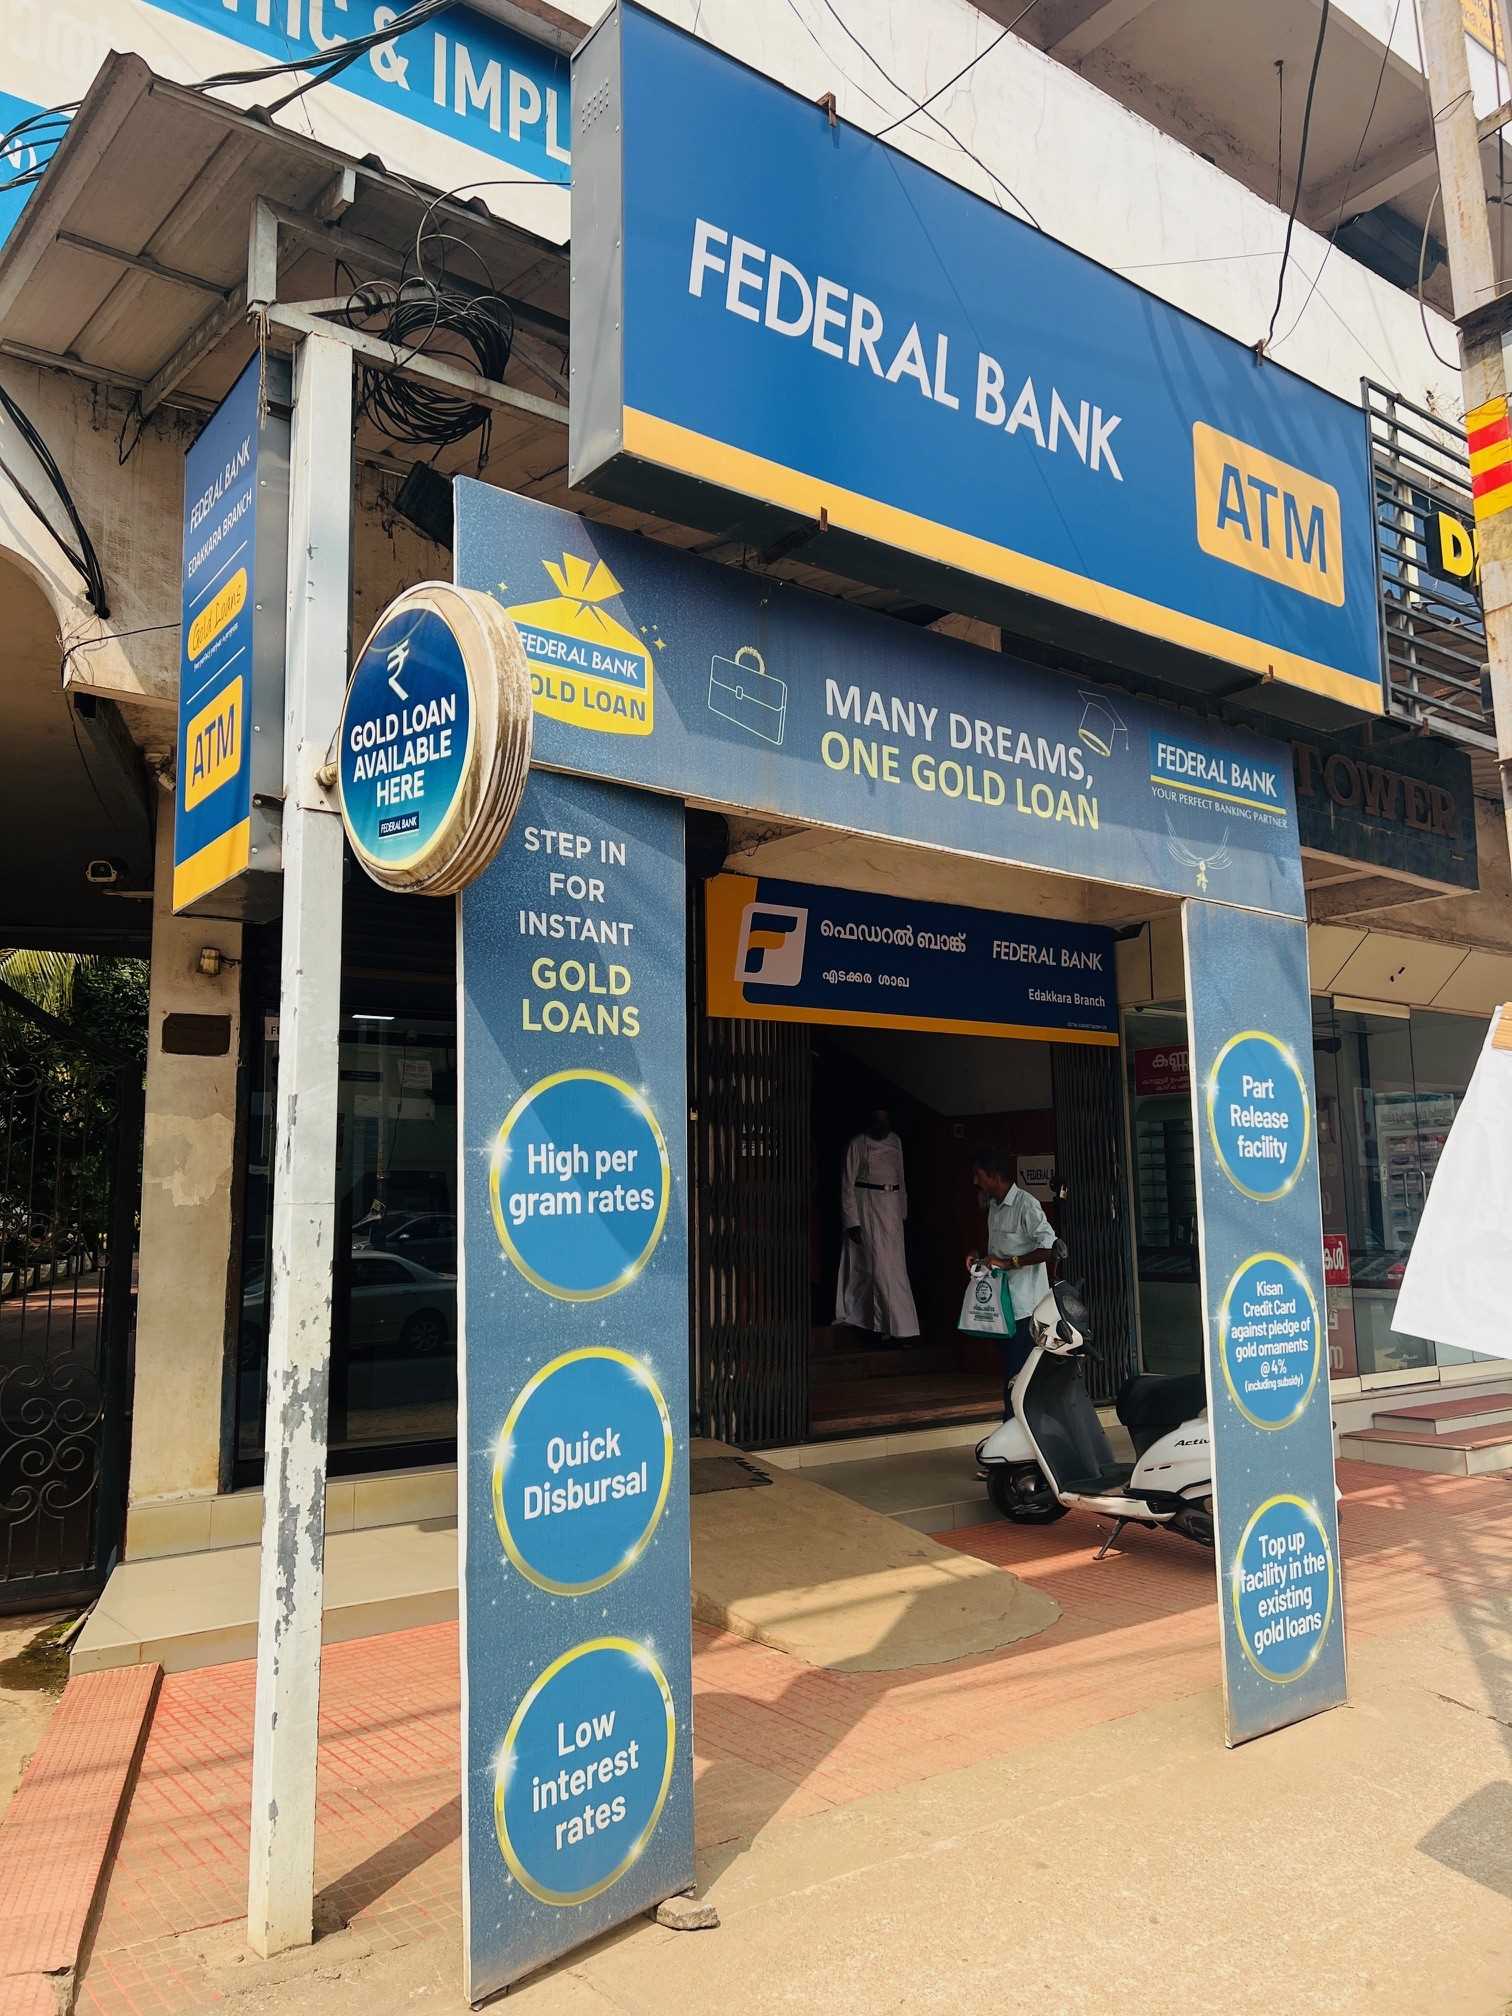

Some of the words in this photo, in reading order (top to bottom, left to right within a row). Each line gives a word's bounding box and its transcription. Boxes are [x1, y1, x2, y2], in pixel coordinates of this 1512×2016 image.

[688, 217, 960, 411] FEDERAL
[975, 351, 1124, 483] BANK
[189, 472, 224, 534] FEDERAL
[224, 434, 252, 488] BANK
[188, 526, 222, 579] EDAKKARA
[222, 488, 253, 536] BRANCH
[1216, 463, 1328, 575] ATM
[591, 651, 639, 680] BANK
[530, 672, 577, 704] OLD
[583, 686, 646, 722] LOAN
[350, 714, 399, 752] GOLD
[402, 693, 456, 736] LOAN
[825, 678, 939, 742] MANY
[949, 712, 1094, 790] DREAMS,
[191, 703, 235, 788] ATM
[353, 728, 452, 783] AVAILABLE
[376, 770, 425, 807] HERE
[820, 730, 901, 784] ONE
[911, 753, 1006, 807] GOLD
[1015, 777, 1099, 830] LOAN
[1157, 742, 1228, 785] FEDERAL
[1231, 763, 1278, 798] BANK
[380, 819, 402, 835] FEDERAL
[401, 815, 419, 830] BANK
[1151, 785, 1177, 801] YOUR
[1179, 793, 1213, 811] PERFECT
[1214, 801, 1252, 821] BANKING
[1253, 813, 1288, 829] PARTNER
[523, 826, 592, 859] STEP
[600, 839, 627, 866] IN
[549, 872, 605, 903] FOR
[519, 910, 634, 946] INSTANT
[531, 957, 632, 995] GOLD
[992, 940, 1057, 966] FEDERAL
[1060, 949, 1103, 972] BANK
[522, 998, 641, 1037] LOANS
[1028, 988, 1072, 1004] Edakkara
[1074, 993, 1106, 1007] Branch
[1242, 1074, 1275, 1099] Part
[1230, 1103, 1289, 1129] Release
[527, 1142, 589, 1182] High
[595, 1149, 638, 1180] per
[1237, 1134, 1288, 1164] facility
[509, 1191, 582, 1225] gram
[588, 1184, 655, 1214] rates
[1243, 1301, 1274, 1318] Credit
[1273, 1298, 1297, 1316] Card
[1256, 1280, 1284, 1297] Kisan
[1231, 1321, 1267, 1342] against
[1268, 1318, 1300, 1339] pledge
[1300, 1316, 1311, 1332] of
[1235, 1341, 1258, 1363] gold
[1257, 1337, 1309, 1356] ornaments
[1244, 1378, 1277, 1394] (including
[1276, 1373, 1304, 1388] subsidy)
[546, 1427, 621, 1474] Quick
[524, 1461, 647, 1520] Disbursal
[1258, 1534, 1286, 1560] Top
[1287, 1531, 1306, 1556] up
[1240, 1561, 1287, 1594] facility
[1288, 1556, 1303, 1580] in
[1302, 1552, 1326, 1576] the
[1258, 1585, 1313, 1618] existing
[1254, 1618, 1285, 1656] gold
[1285, 1612, 1322, 1640] loans
[557, 1710, 616, 1757] Low
[532, 1740, 640, 1813] interest
[555, 1795, 627, 1851] rates
